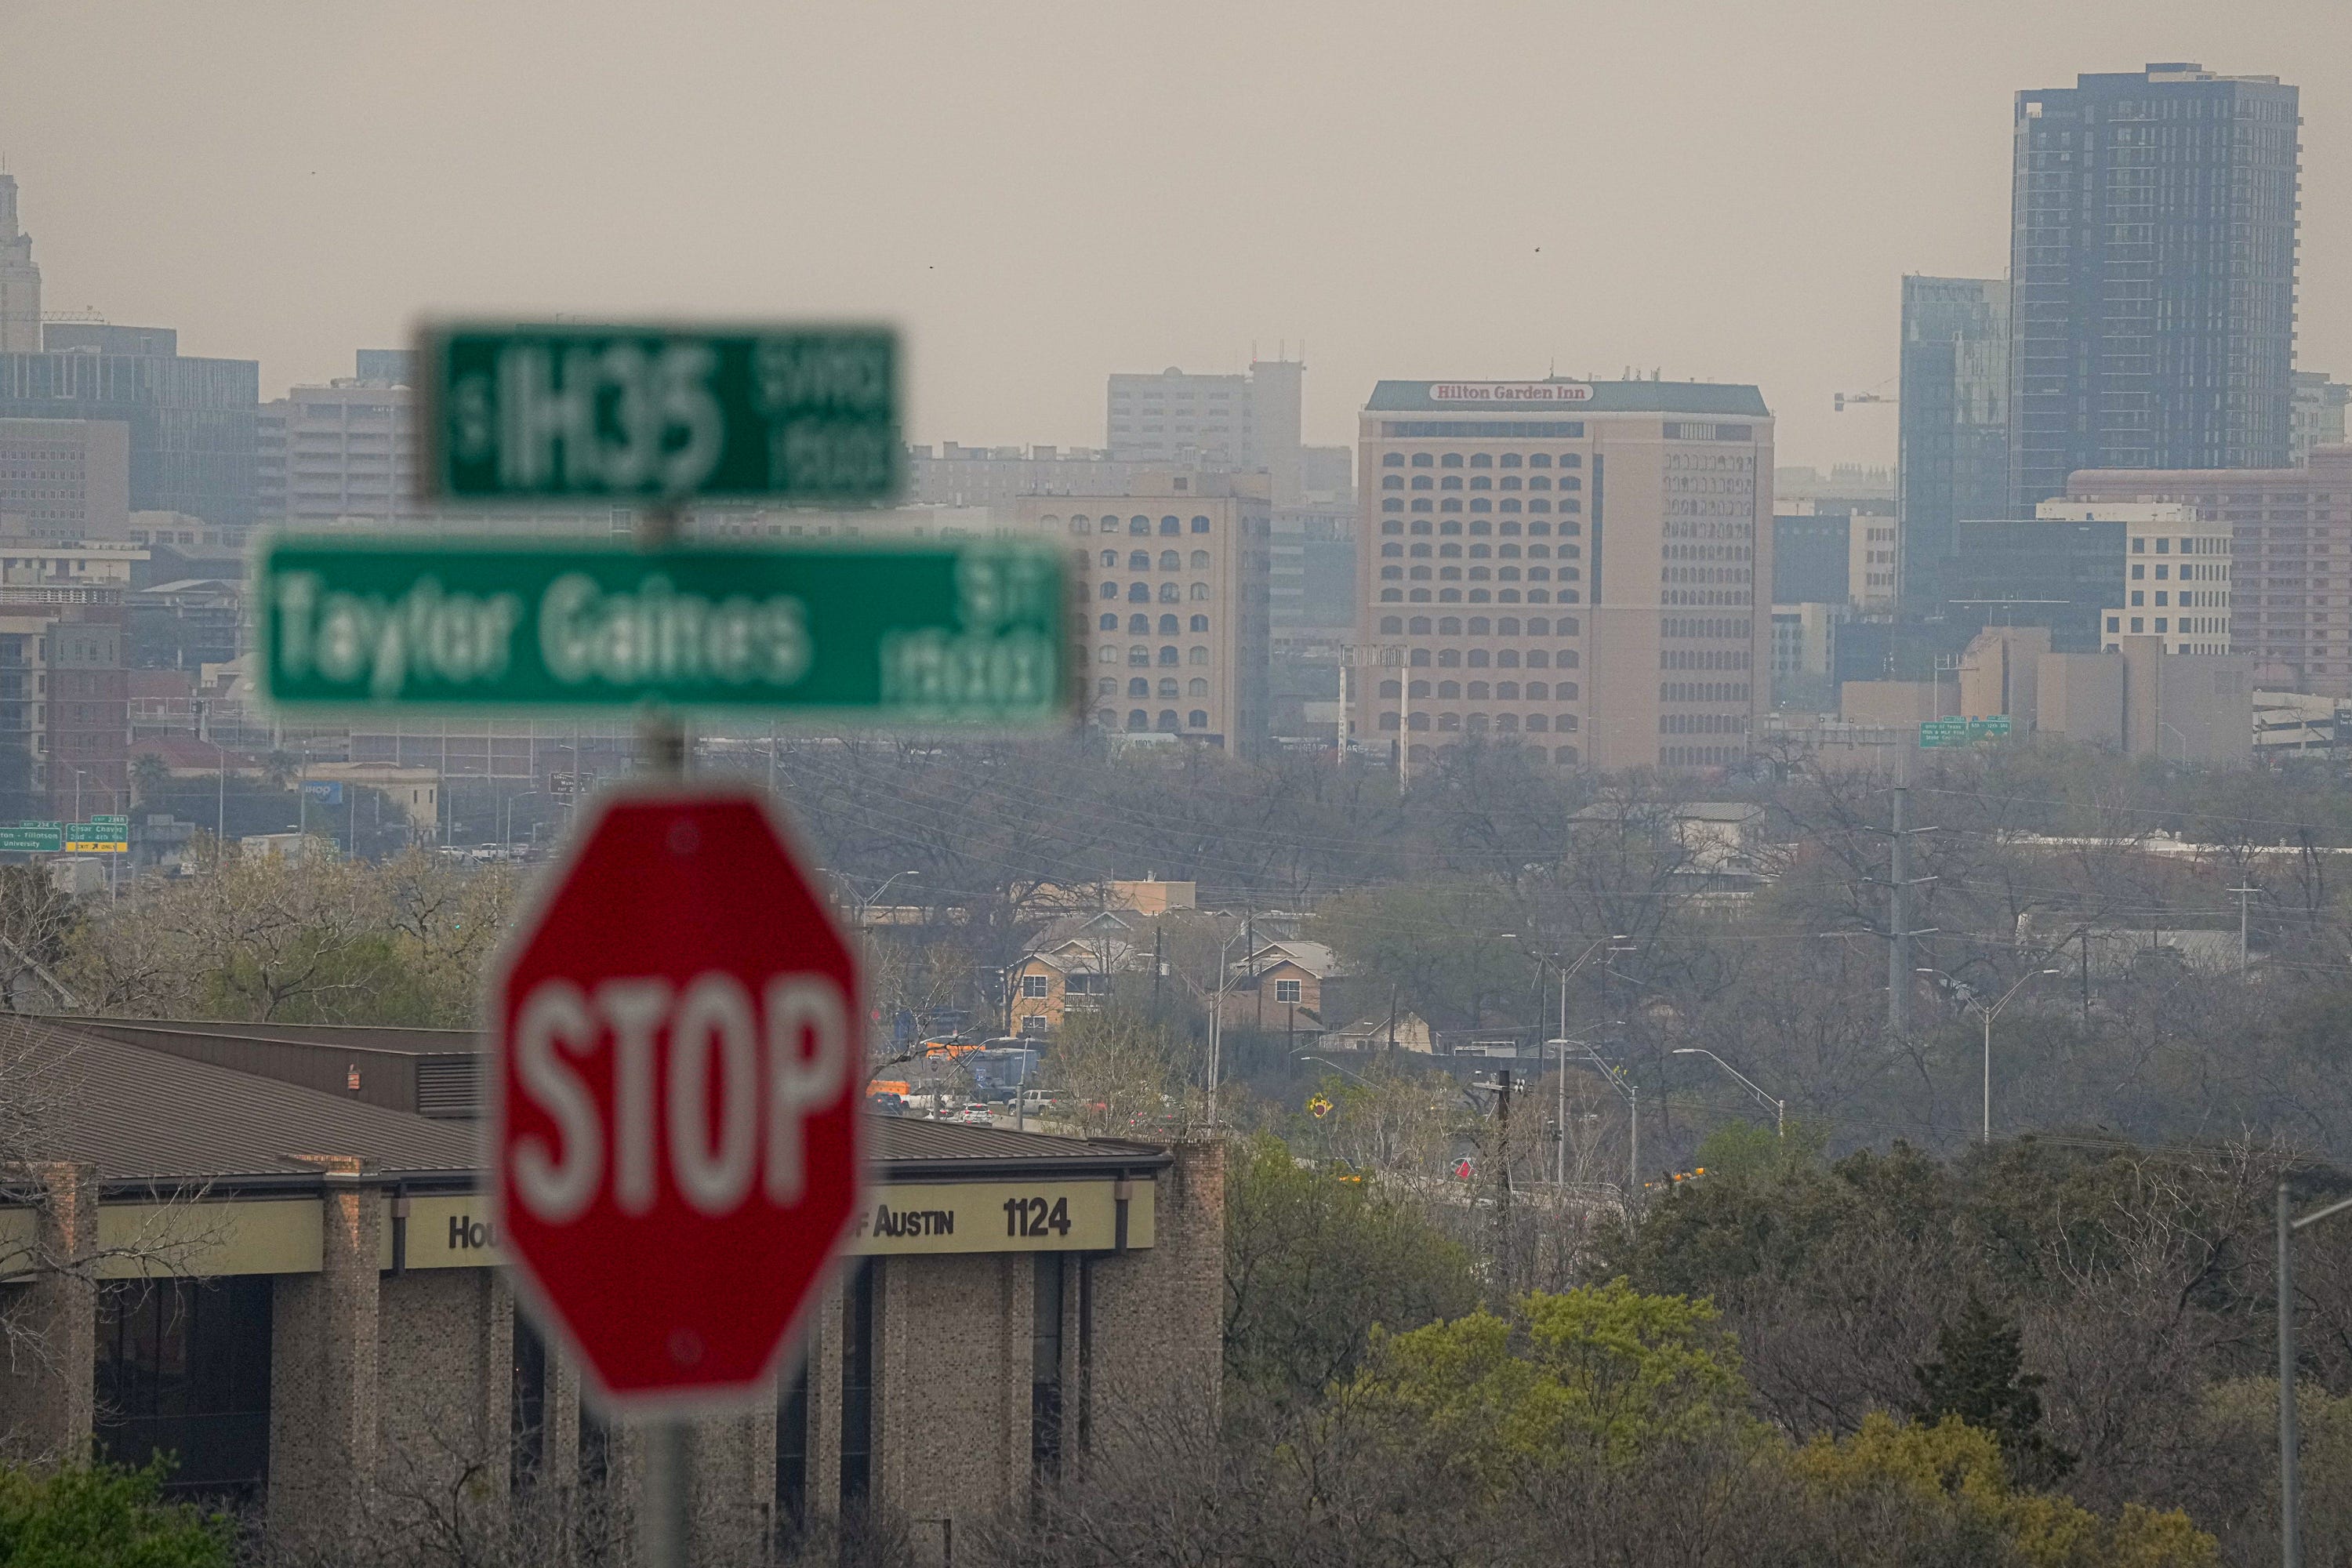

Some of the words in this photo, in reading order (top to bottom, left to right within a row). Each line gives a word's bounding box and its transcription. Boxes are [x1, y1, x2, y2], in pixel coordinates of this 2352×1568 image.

[500, 345, 720, 488] IH35
[1437, 385, 1490, 399] Hilton
[1494, 386, 1553, 399] Garden
[1556, 386, 1585, 399] Inn
[273, 572, 519, 698] Taylor
[541, 576, 811, 684] Gaines
[24, 831, 59, 840] Tillotson
[511, 974, 852, 1221] STOP
[1004, 1197, 1071, 1236] 1124
